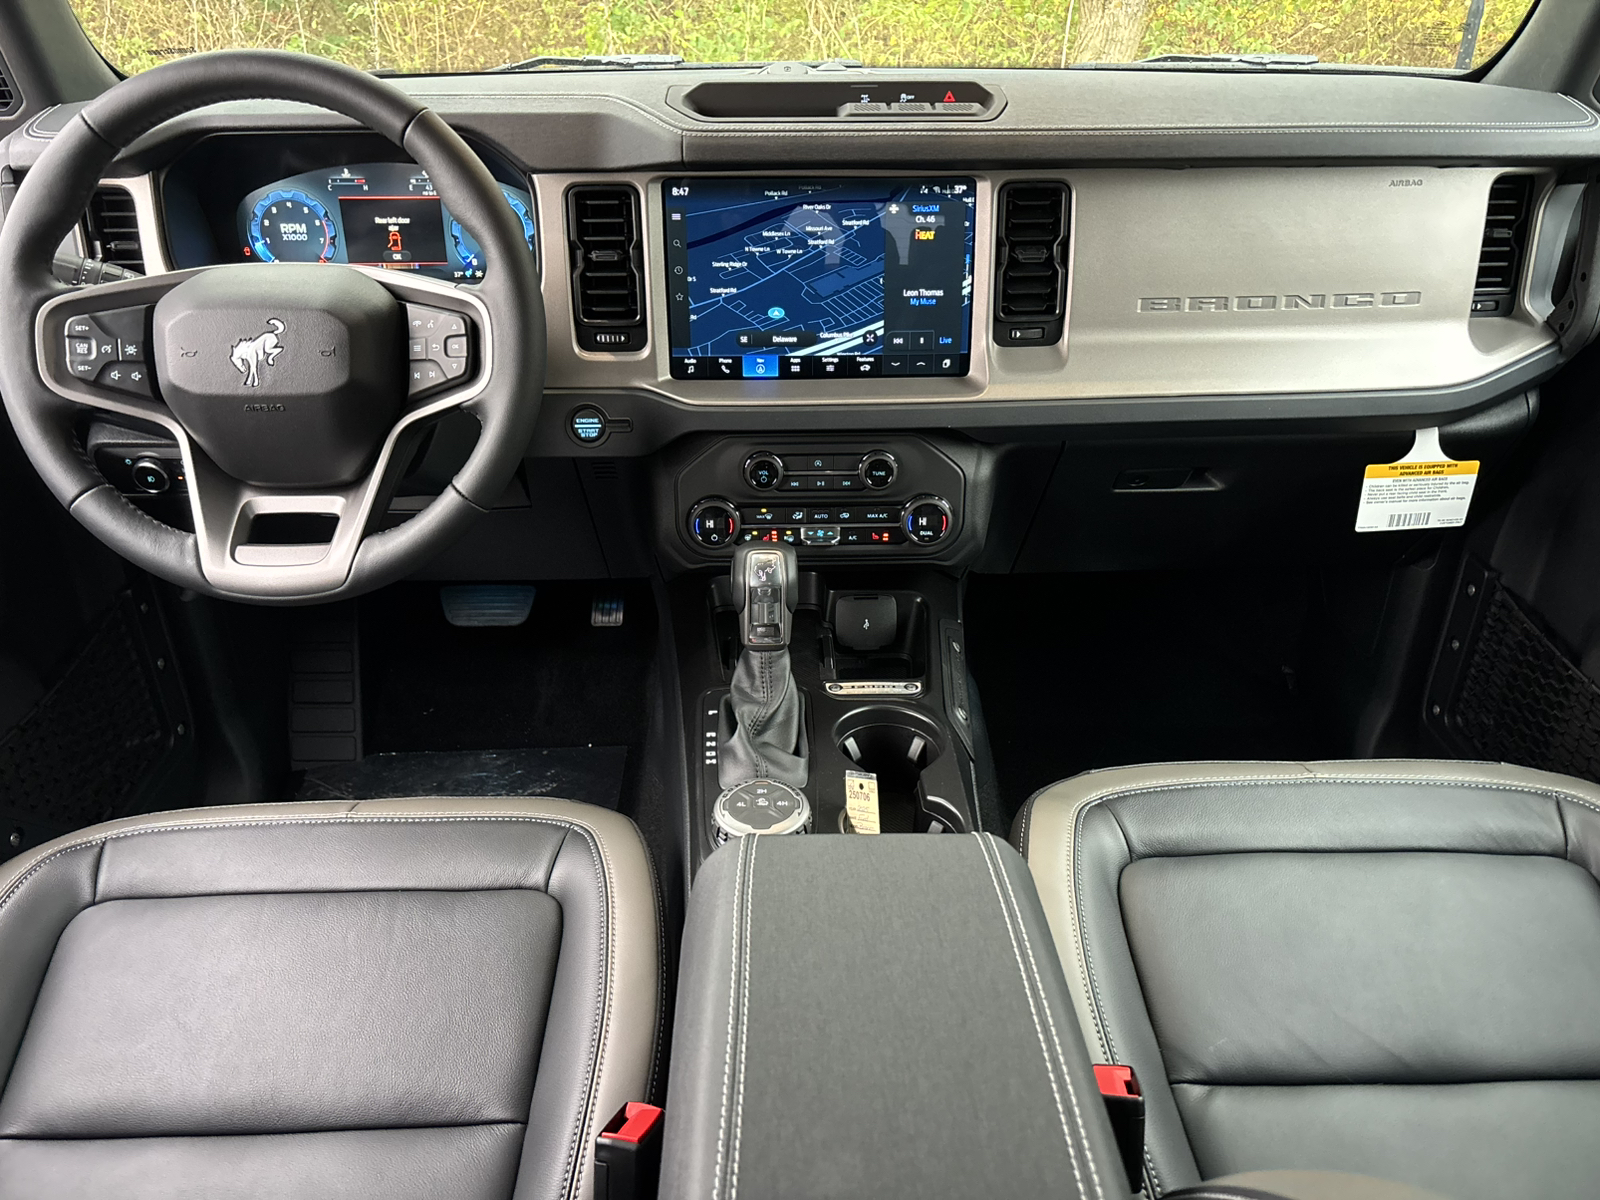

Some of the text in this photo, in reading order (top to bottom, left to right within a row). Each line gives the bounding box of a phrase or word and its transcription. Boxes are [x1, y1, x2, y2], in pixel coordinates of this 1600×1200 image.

[1388, 179, 1423, 187] AIRBAG
[672, 187, 689, 196] 8:47
[280, 224, 307, 234] RPM
[910, 298, 919, 306] My
[1136, 291, 1421, 313] BRONCO
[244, 404, 286, 412] AIRBAG
[706, 520, 714, 528] HI
[918, 517, 927, 526] HI
[849, 790, 870, 802] 250706
